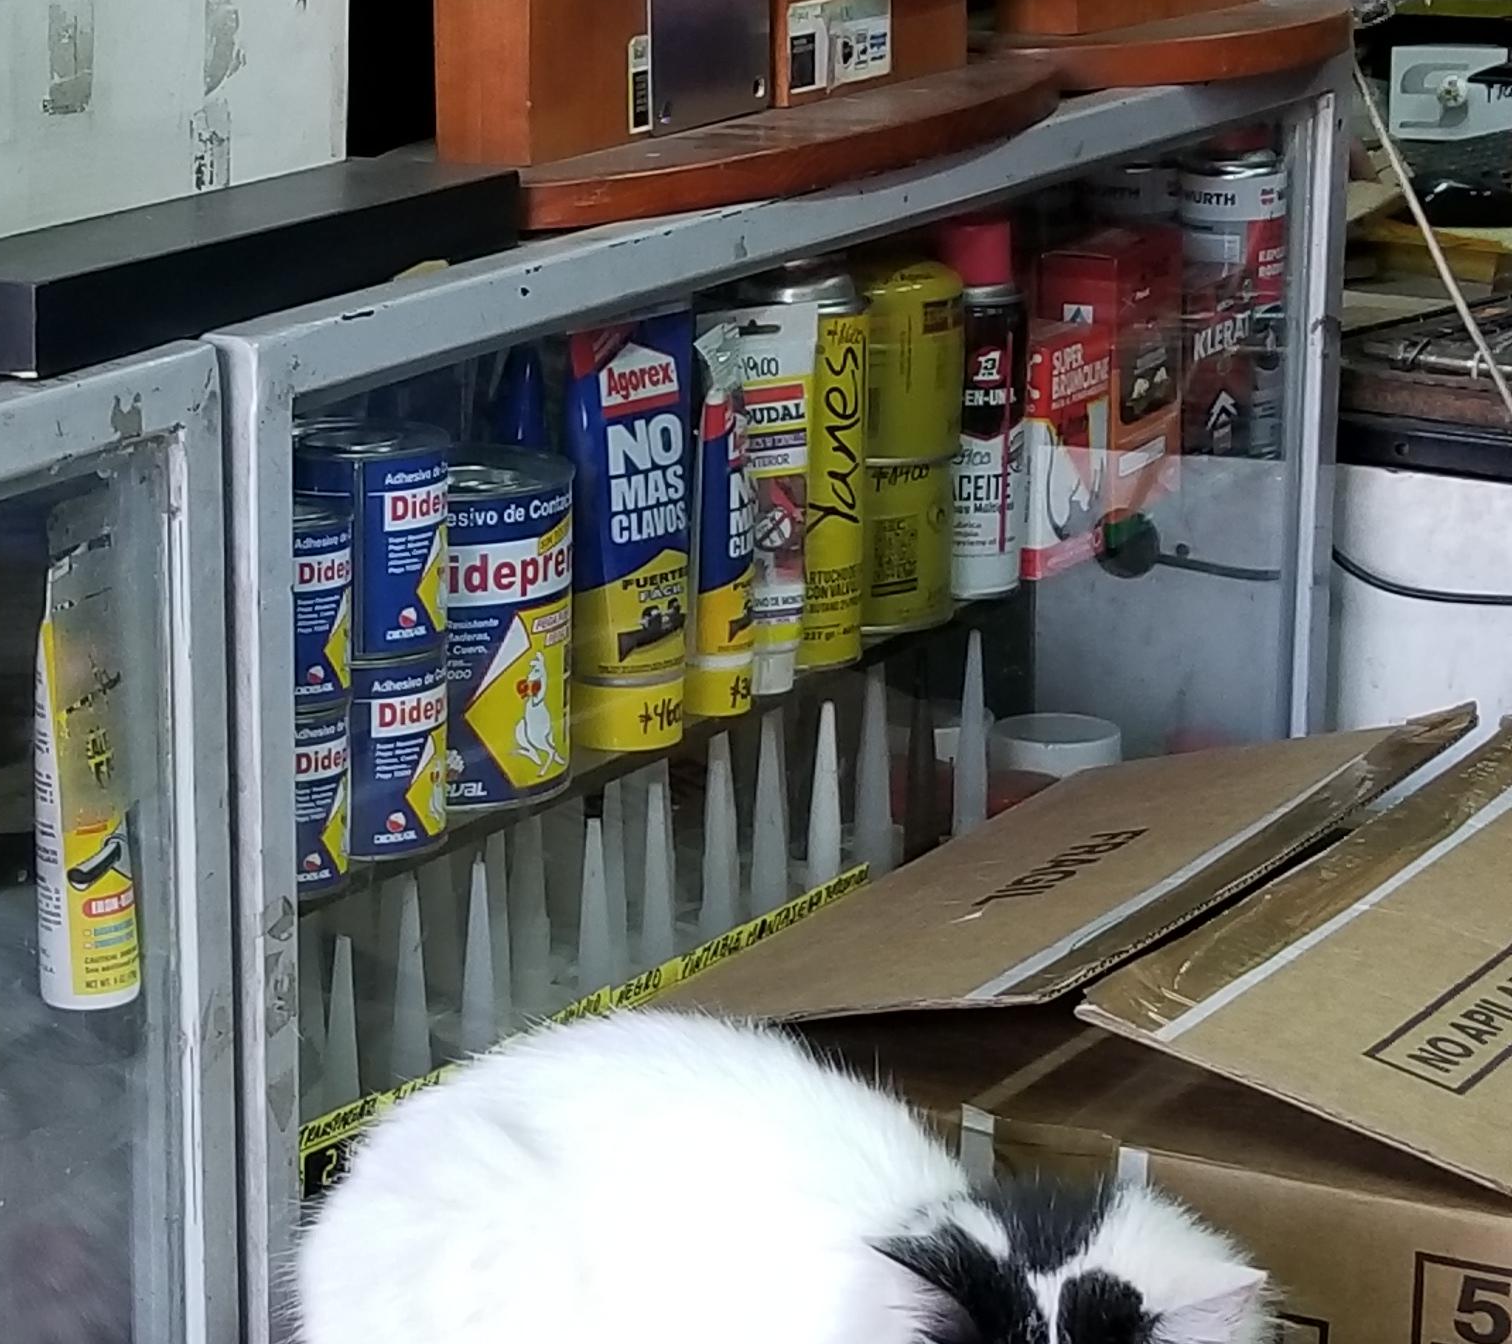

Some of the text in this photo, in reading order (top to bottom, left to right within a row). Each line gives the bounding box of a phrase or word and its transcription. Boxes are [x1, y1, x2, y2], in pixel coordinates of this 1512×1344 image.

[605, 362, 675, 401] Agorex
[607, 413, 683, 477] NO
[806, 345, 864, 535] Yanes
[385, 468, 428, 486] Adhesivo
[610, 466, 685, 515] MAS
[447, 502, 525, 529] esivo de
[610, 501, 687, 544] CLAVOS
[371, 676, 421, 695] Adhesivo
[978, 827, 1149, 907] FRAGIL
[616, 966, 663, 1004] NEGRO
[1407, 1035, 1474, 1074] NO
